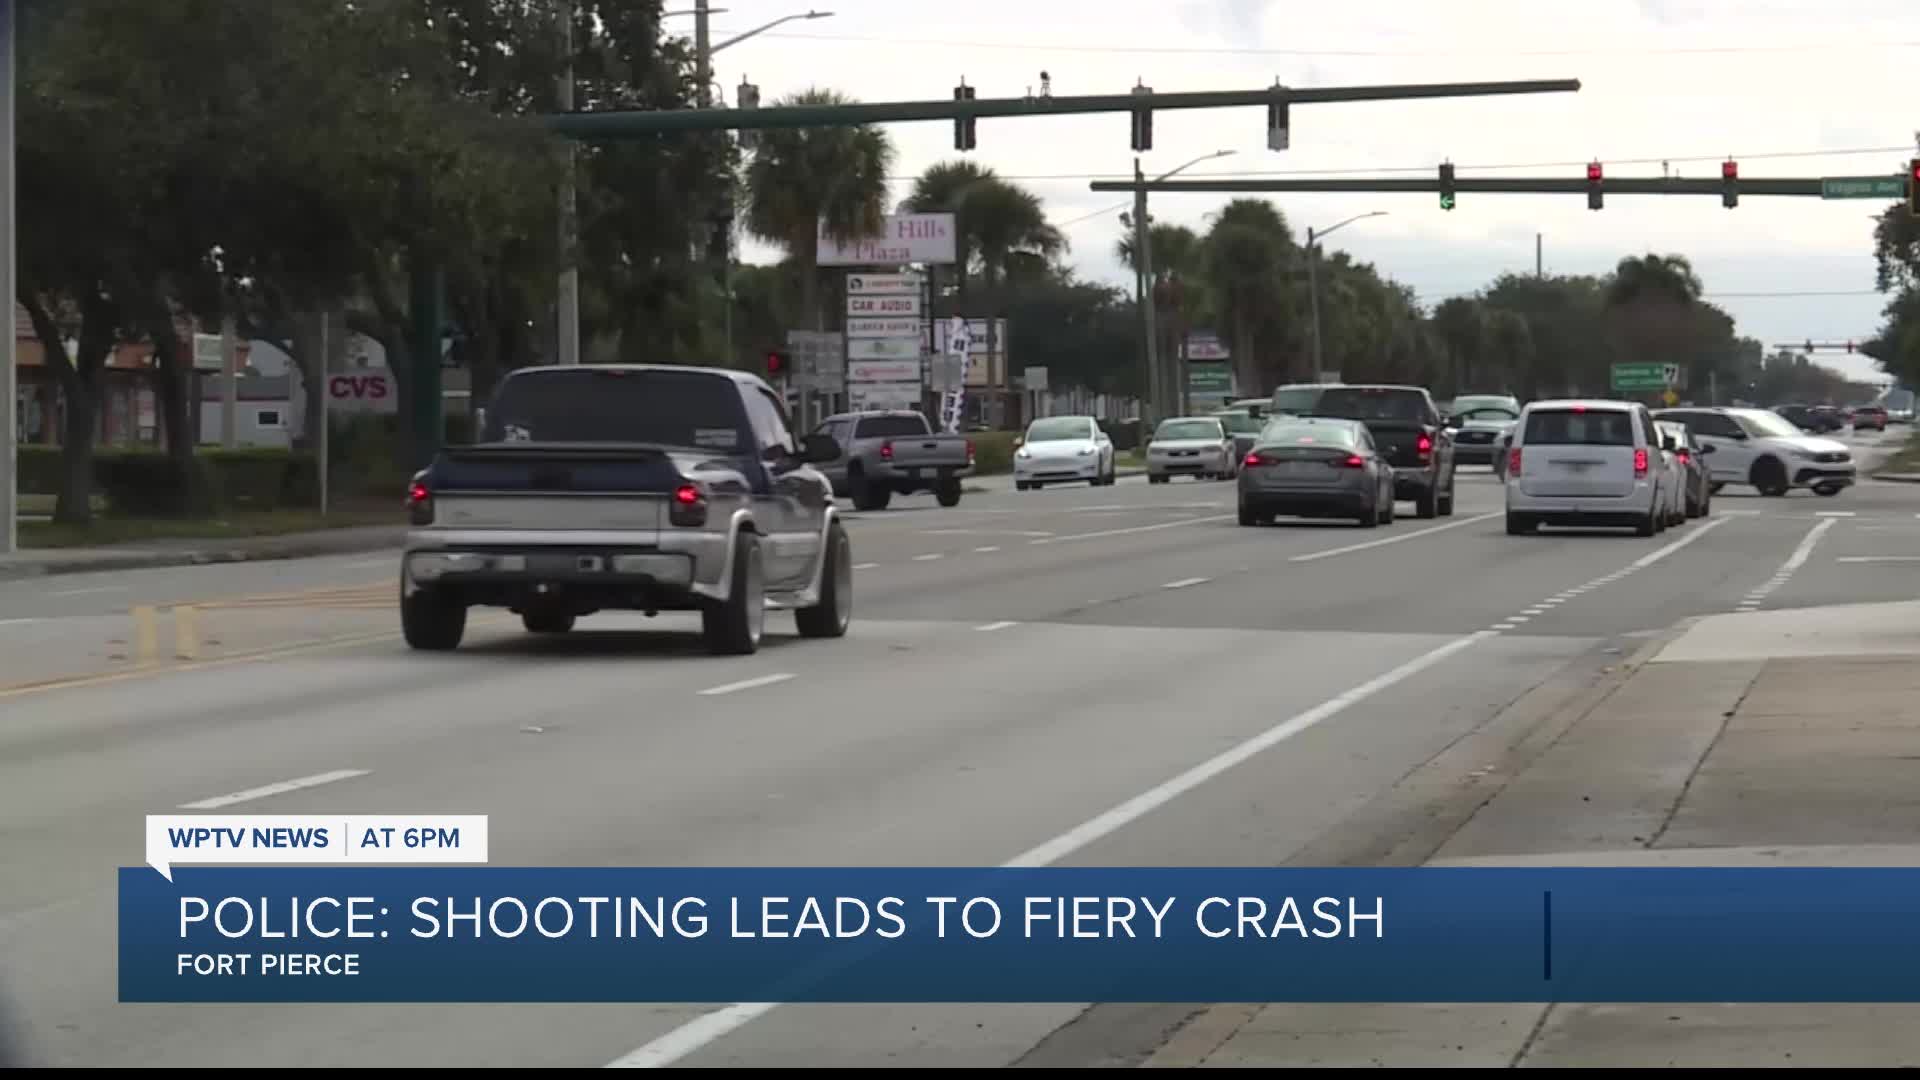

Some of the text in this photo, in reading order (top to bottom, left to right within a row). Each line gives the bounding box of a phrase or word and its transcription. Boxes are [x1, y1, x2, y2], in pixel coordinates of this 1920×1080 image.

[898, 219, 945, 239] Hills
[855, 241, 911, 260] Plaza
[852, 300, 912, 311] CAR AUDIO
[329, 376, 387, 399] CVS
